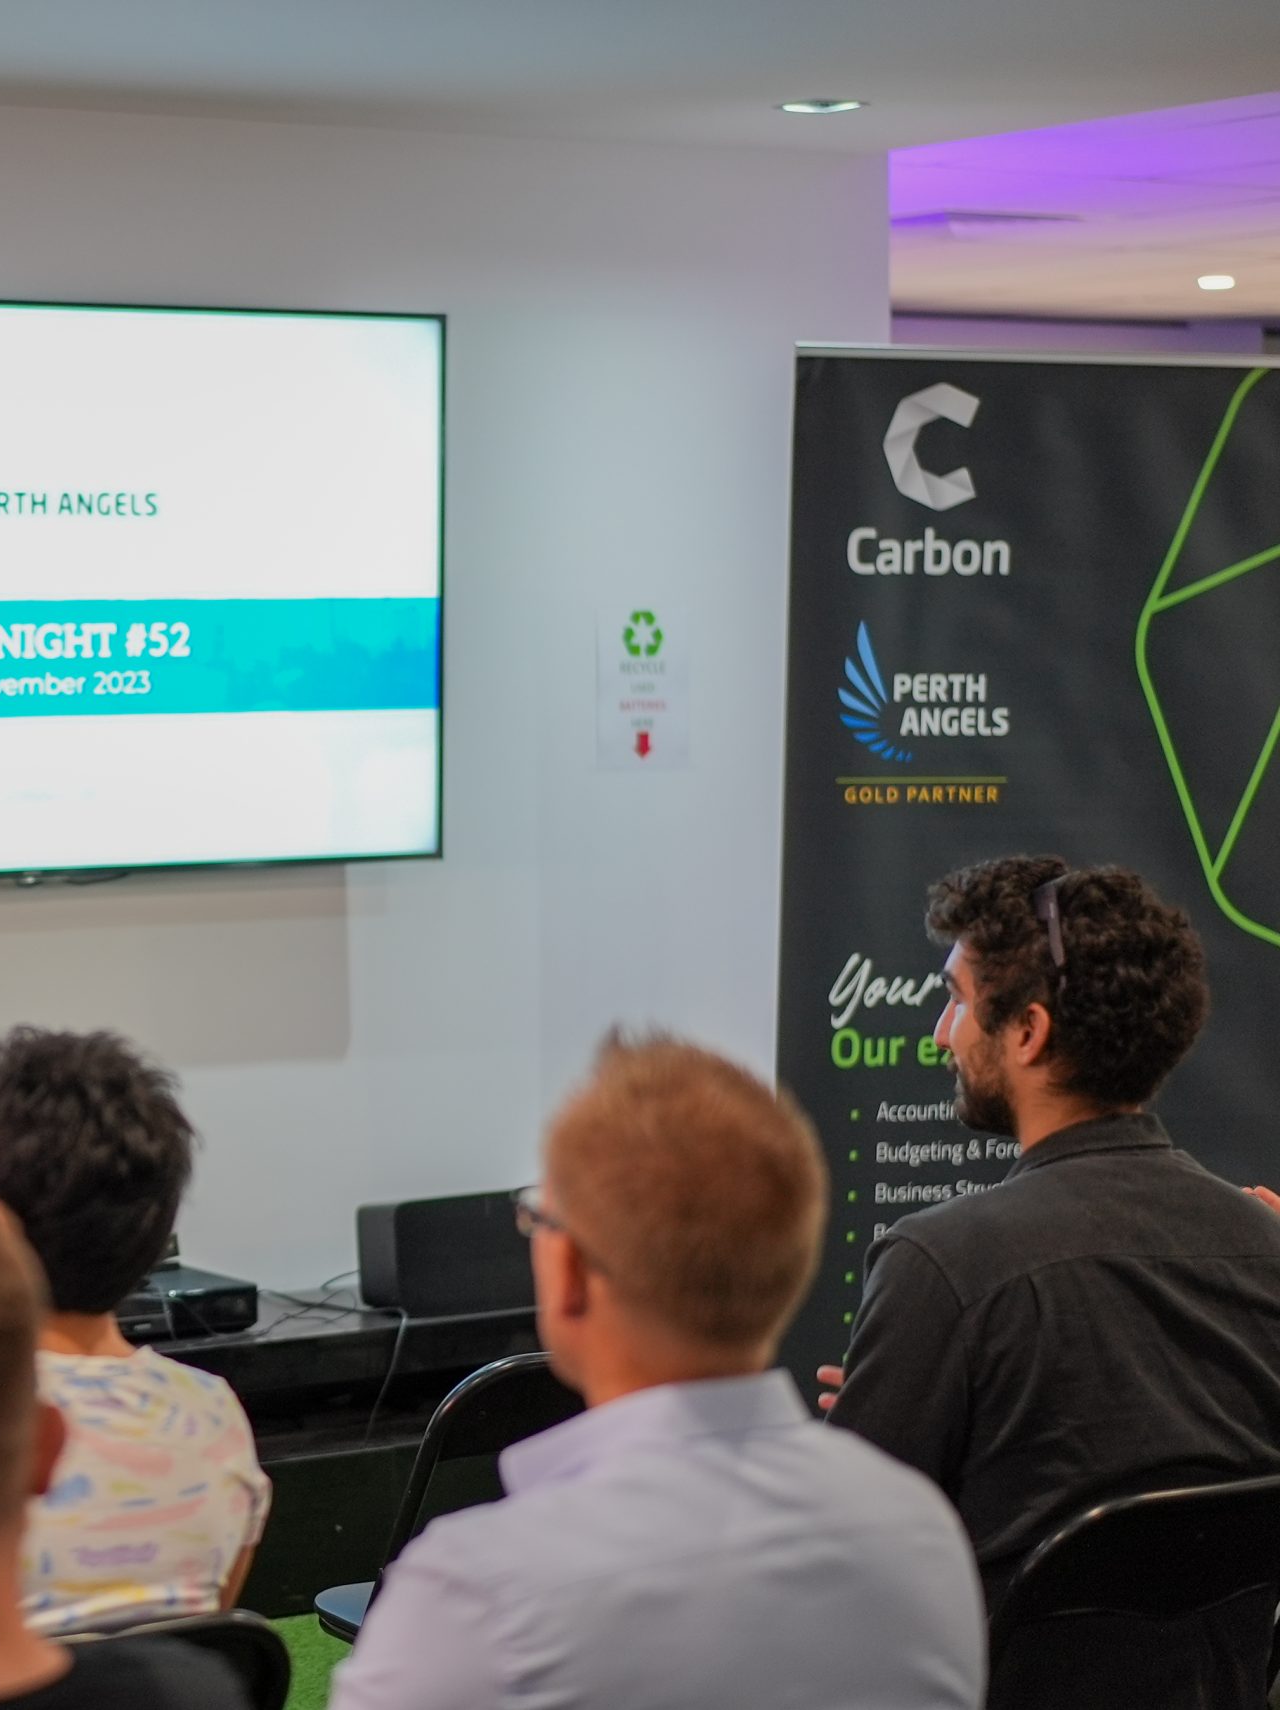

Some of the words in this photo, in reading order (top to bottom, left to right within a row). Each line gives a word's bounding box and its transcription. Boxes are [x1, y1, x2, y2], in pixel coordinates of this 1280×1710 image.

[58, 492, 159, 517] ANGELS
[846, 527, 1011, 576] Carbon
[124, 621, 192, 658] #52
[93, 670, 152, 695] 2023
[893, 673, 987, 702] PERTH
[899, 707, 1010, 737] ANGELS
[844, 785, 899, 804] GOLD
[906, 785, 1000, 803] PARTNER
[828, 952, 944, 1029] Your
[831, 1027, 906, 1069] Our
[917, 1034, 952, 1067] e
[876, 1139, 965, 1168] Budgeting
[967, 1138, 981, 1161] &
[875, 1182, 953, 1204] Business
